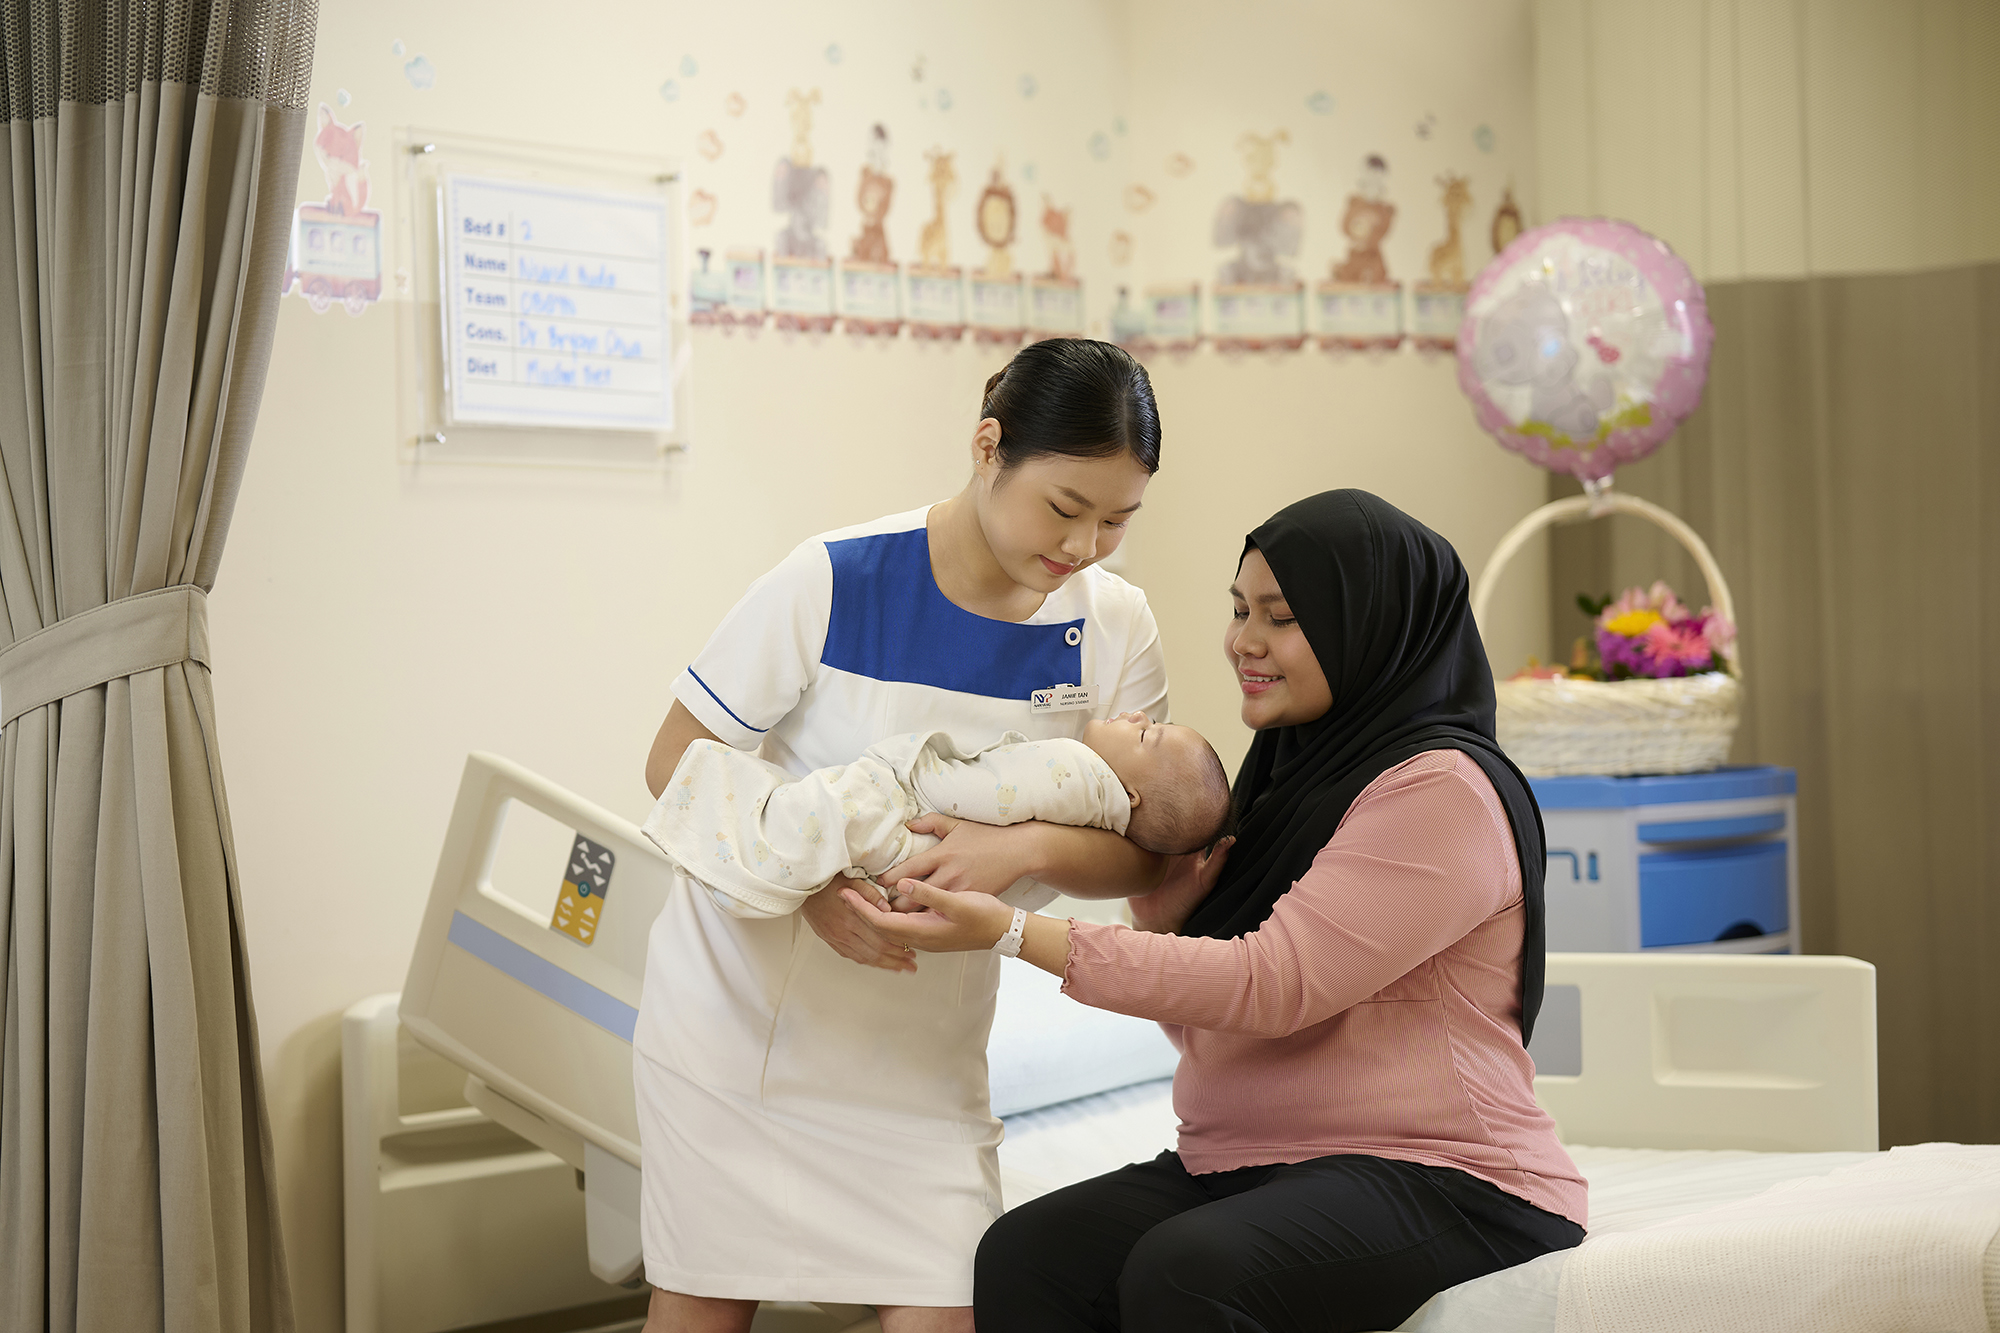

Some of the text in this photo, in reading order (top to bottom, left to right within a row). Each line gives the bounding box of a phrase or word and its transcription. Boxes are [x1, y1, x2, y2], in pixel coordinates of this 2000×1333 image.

[463, 216, 492, 236] Bed
[520, 219, 533, 241] 2
[464, 253, 507, 272] Name
[465, 287, 507, 306] Team
[466, 322, 508, 341] Cons.
[466, 357, 497, 375] Diet
[1034, 692, 1053, 703] NYP
